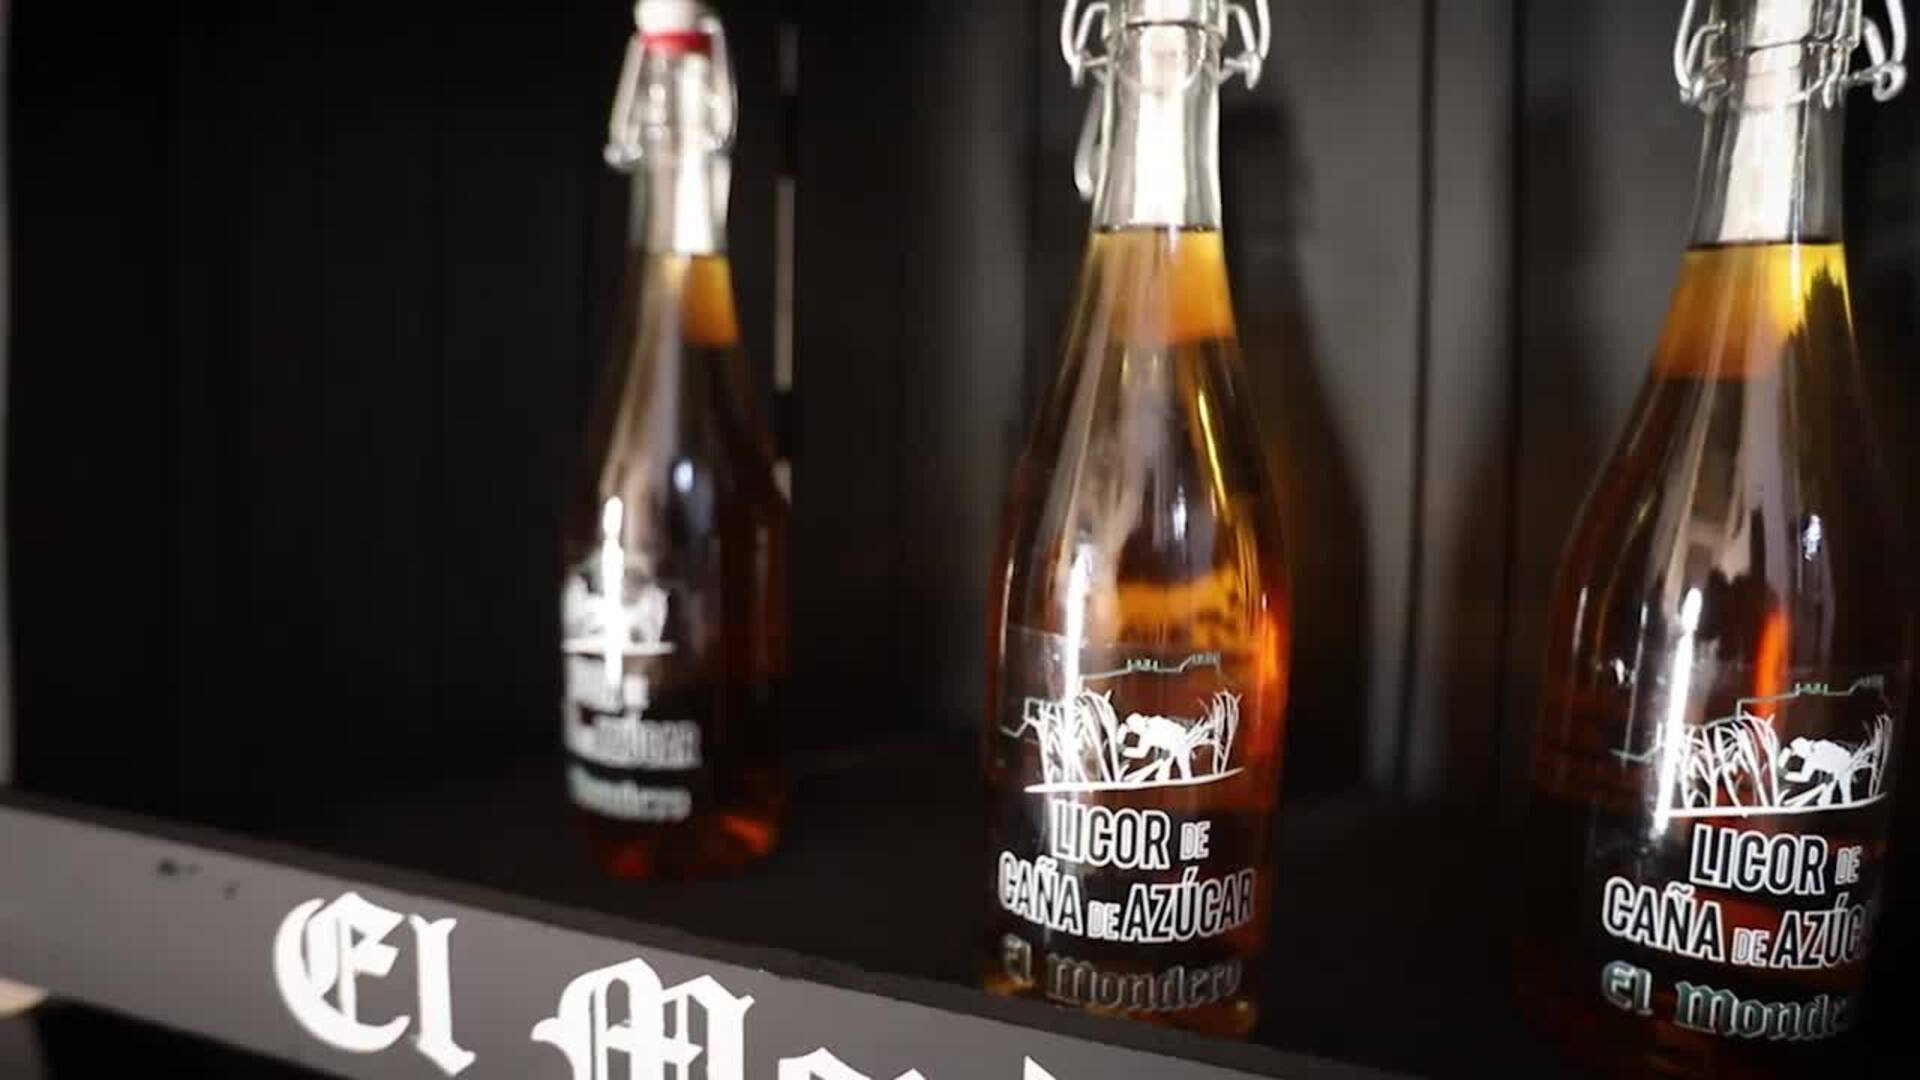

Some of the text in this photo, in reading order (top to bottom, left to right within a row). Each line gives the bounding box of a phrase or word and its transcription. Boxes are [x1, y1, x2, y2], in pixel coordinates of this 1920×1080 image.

[1049, 797, 1212, 870] LICOR DE
[1689, 823, 1863, 896] LICOR DE
[998, 850, 1256, 943] CAÑA DE AZÚCAR
[1602, 874, 1874, 970] CAÑA DE AZÚC
[272, 890, 478, 1077] El
